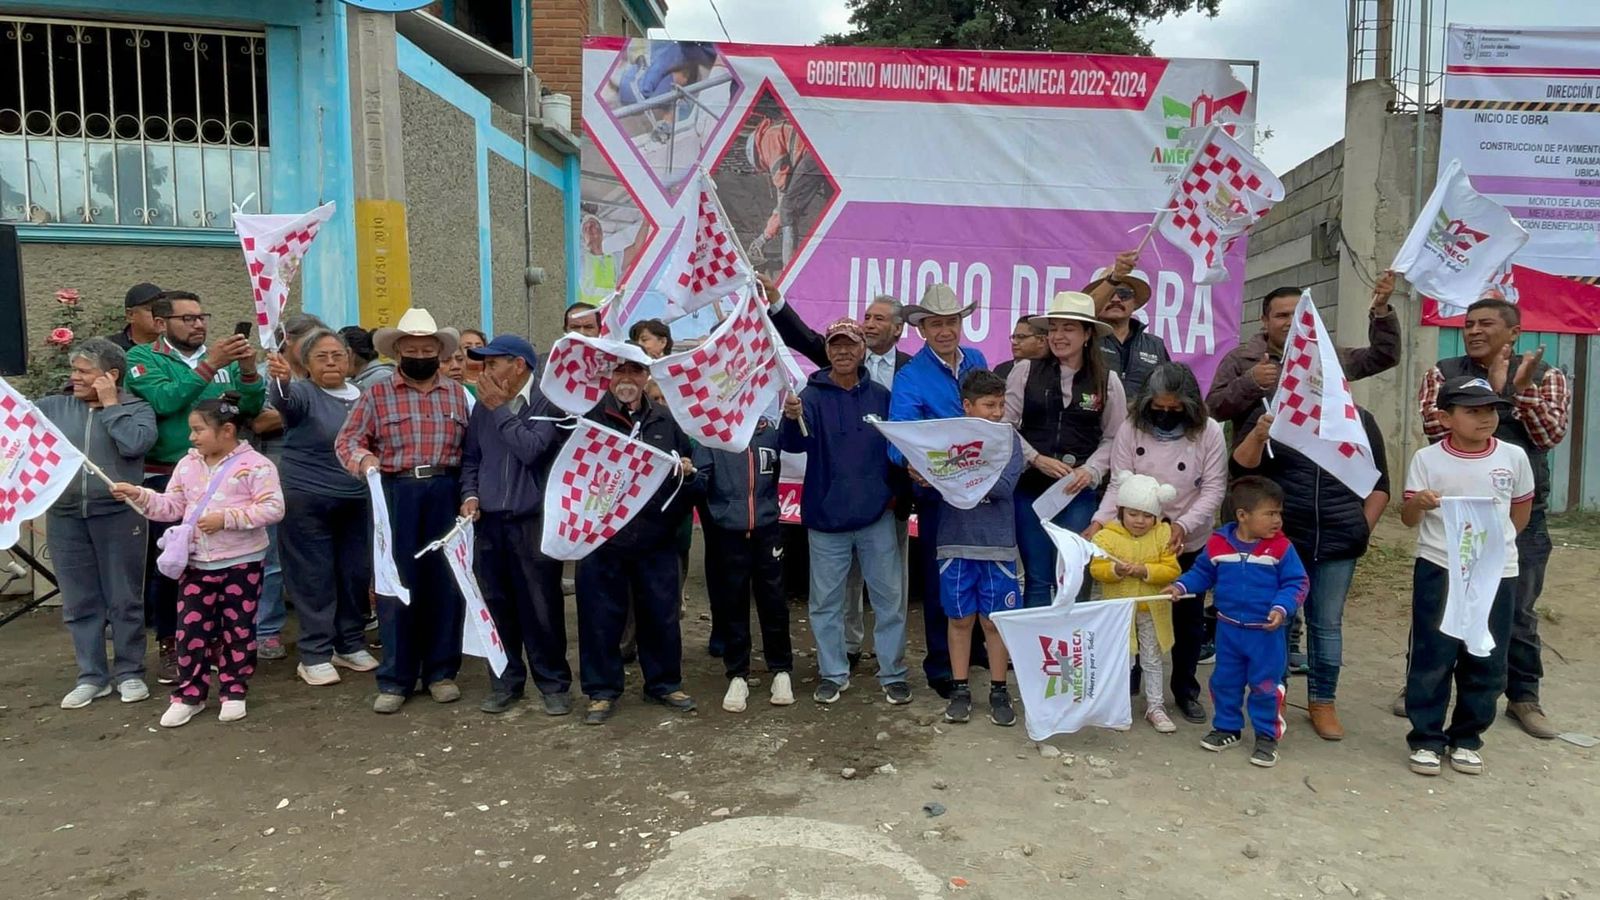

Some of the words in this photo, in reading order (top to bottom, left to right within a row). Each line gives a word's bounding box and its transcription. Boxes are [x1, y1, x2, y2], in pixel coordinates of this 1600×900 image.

[806, 60, 876, 88] GOBIERNO
[879, 63, 954, 91] MUNICIPAL
[957, 66, 976, 92] DE
[978, 67, 1066, 95] AMECAMECA
[1069, 69, 1148, 98] 2022-2024
[1546, 83, 1593, 99] DIRECCIÓN
[1474, 113, 1504, 123] INICIO
[1505, 114, 1518, 124] DE
[1520, 114, 1549, 125] OBRA
[1480, 141, 1542, 152] CONSTRUCCION
[1544, 144, 1555, 152] DE
[1534, 155, 1560, 164] CALLE
[1528, 197, 1557, 206] MONTO
[1558, 198, 1570, 207] DE
[1571, 199, 1582, 207] LA
[1528, 209, 1556, 218] METAS
[1557, 210, 1563, 218] A
[1541, 220, 1595, 231] BENEFICIADA
[1090, 266, 1216, 355] RA
[1072, 628, 1083, 704] AMECAMECA
